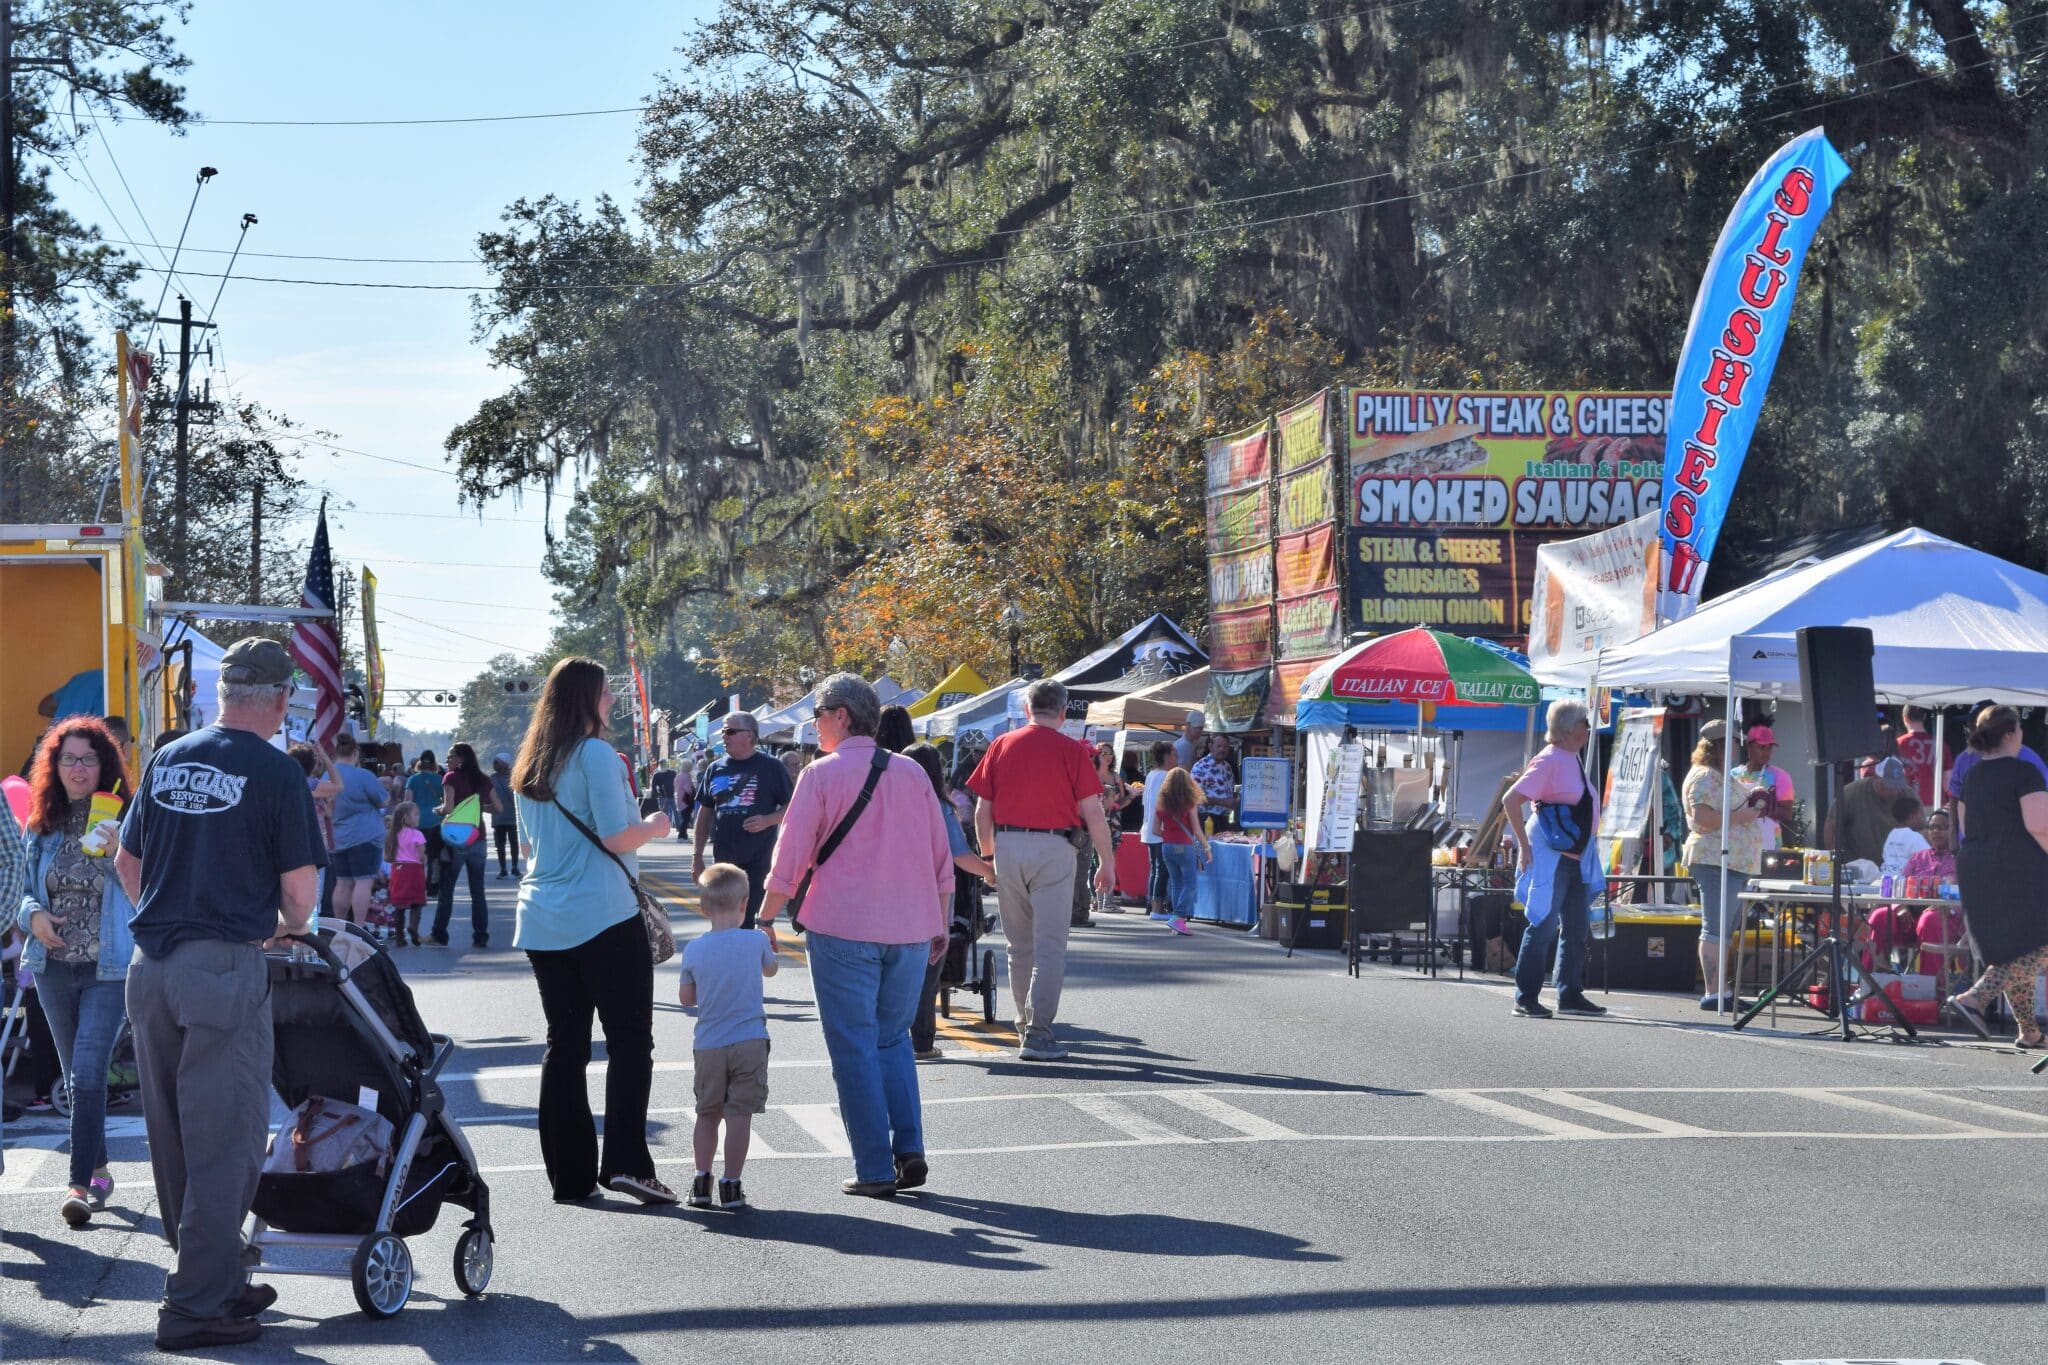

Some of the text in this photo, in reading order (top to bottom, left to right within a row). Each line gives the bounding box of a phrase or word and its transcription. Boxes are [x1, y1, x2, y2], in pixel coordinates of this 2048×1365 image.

[1664, 167, 1815, 539] SLUSHIES
[1357, 395, 1450, 432] PHILLY
[1456, 397, 1545, 433] STEAK
[1551, 398, 1571, 434] &
[1526, 461, 1592, 478] Italian
[1597, 461, 1613, 479] &
[1360, 478, 1508, 524] SMOKED
[1359, 537, 1502, 564] STEAK & CHEESE
[1383, 568, 1480, 594] SAUSAGES
[1361, 598, 1444, 624] BLOOMIN
[1446, 598, 1504, 624] ONION
[1339, 678, 1408, 693] ITALIAN
[1411, 678, 1444, 695] ICE
[1508, 684, 1535, 699] ICE
[1066, 699, 1089, 711] ARD
[170, 790, 209, 804] SERVICE
[189, 770, 248, 807] GLASS
